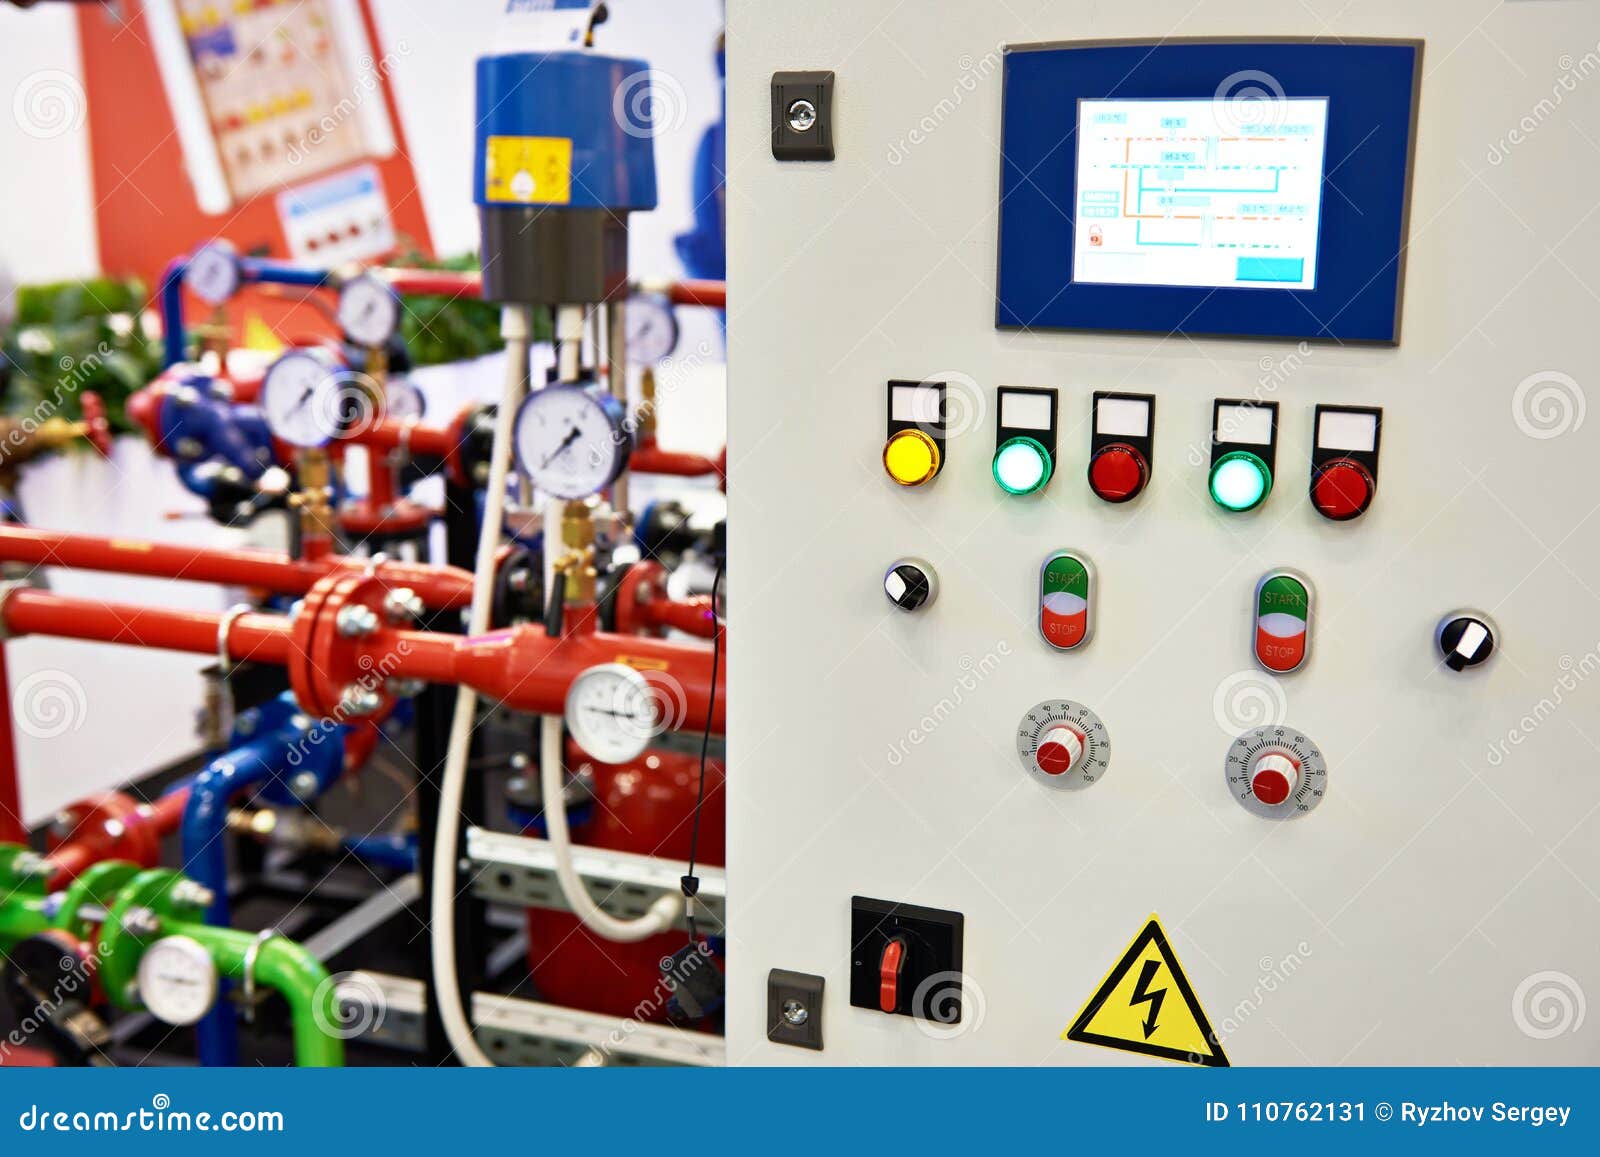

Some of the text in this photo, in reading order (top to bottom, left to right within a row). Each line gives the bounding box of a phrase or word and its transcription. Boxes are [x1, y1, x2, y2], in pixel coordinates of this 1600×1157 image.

[1048, 571, 1082, 584] START
[1265, 591, 1301, 607] START
[1050, 622, 1076, 635] STOP
[1265, 644, 1295, 658] STOP
[1238, 739, 1247, 747] 30
